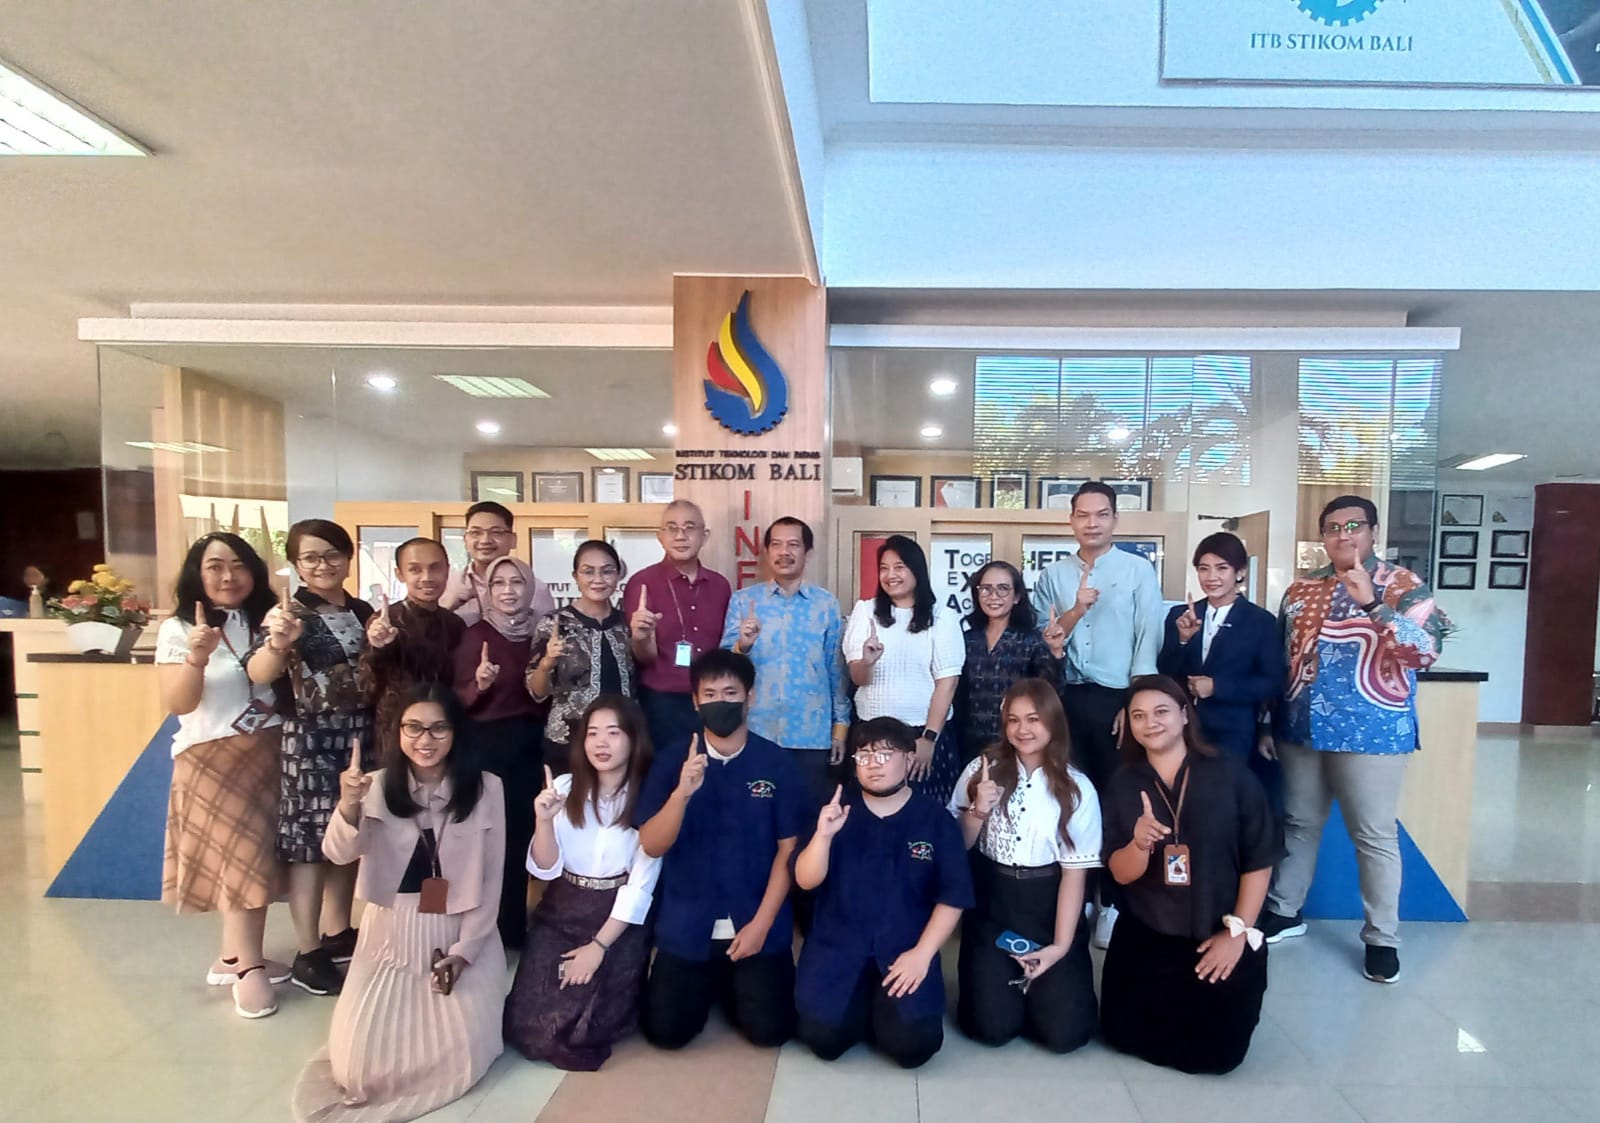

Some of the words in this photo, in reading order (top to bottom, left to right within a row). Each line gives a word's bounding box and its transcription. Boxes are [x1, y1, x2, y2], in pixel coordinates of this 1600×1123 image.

[1251, 33, 1282, 49] ITB
[1286, 33, 1364, 50] STIKOM
[1370, 35, 1413, 51] BALI
[675, 463, 755, 480] STIKOM
[769, 463, 821, 480] BALI
